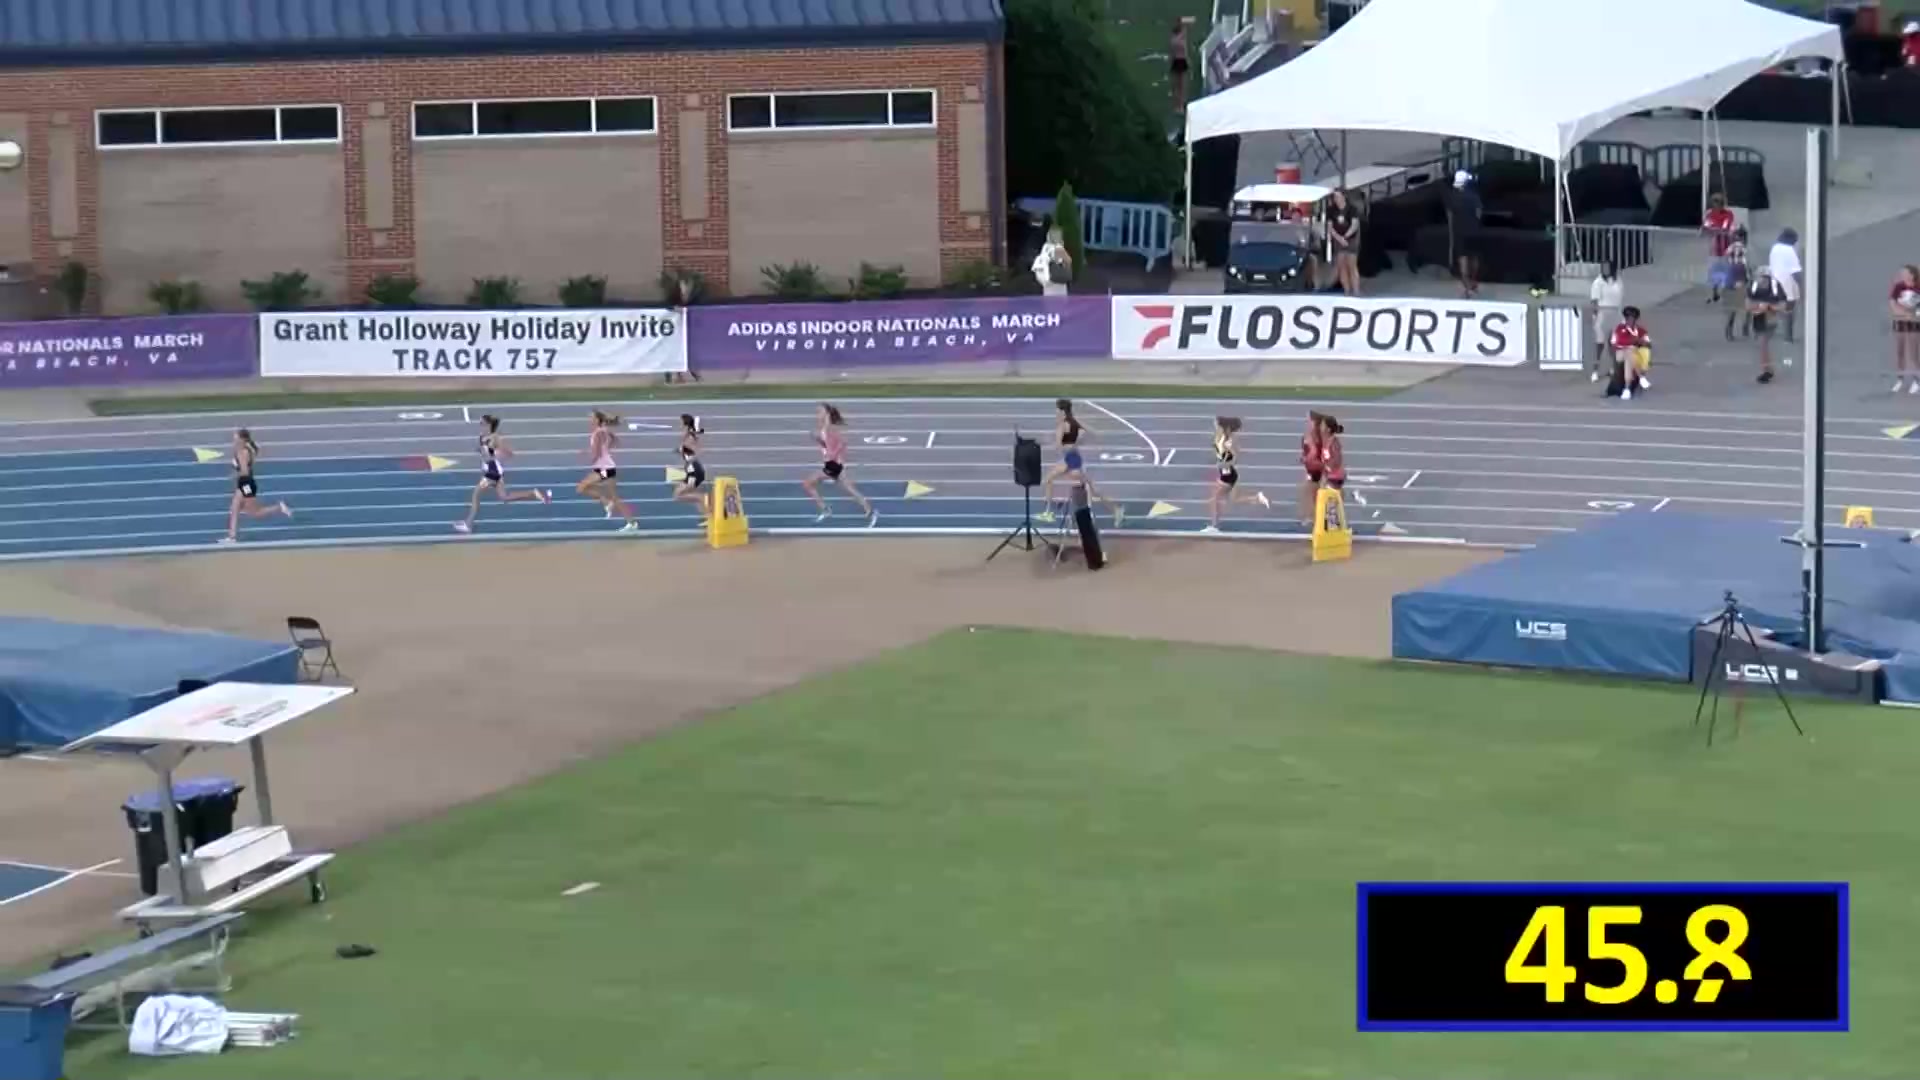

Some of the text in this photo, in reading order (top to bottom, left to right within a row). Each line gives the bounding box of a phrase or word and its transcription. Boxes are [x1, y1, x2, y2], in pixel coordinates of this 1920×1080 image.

[274, 314, 675, 346] Grant Holloway Holiday Invite
[727, 313, 1060, 336] ADIDAS INDOOR NATIONALS MARCH
[18, 335, 123, 353] NATIONALS
[134, 332, 204, 348] MARCH
[756, 338, 876, 351] VIRGINIA
[392, 348, 558, 371] TRACK 757
[1515, 619, 1567, 636] UCS
